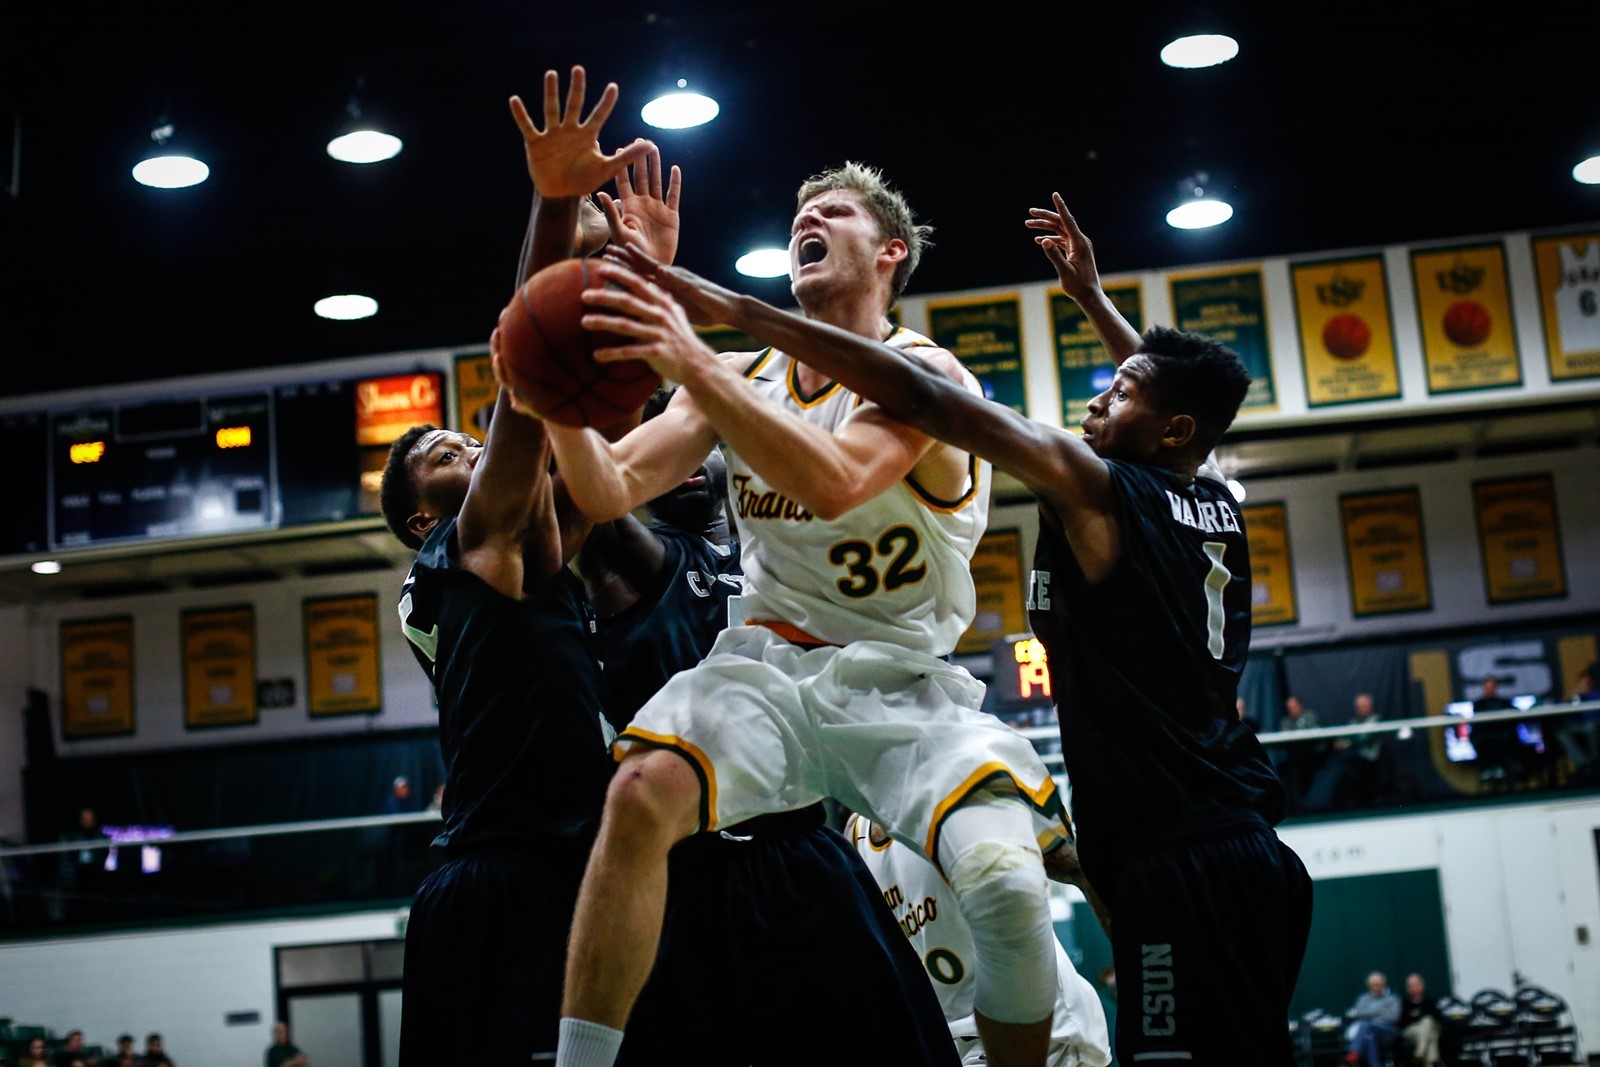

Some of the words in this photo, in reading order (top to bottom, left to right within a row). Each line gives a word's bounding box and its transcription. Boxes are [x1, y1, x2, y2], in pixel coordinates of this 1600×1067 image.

[827, 523, 928, 599] 32
[1202, 541, 1232, 660] 1
[925, 946, 966, 985] 0
[1141, 943, 1176, 1037] CSUN
